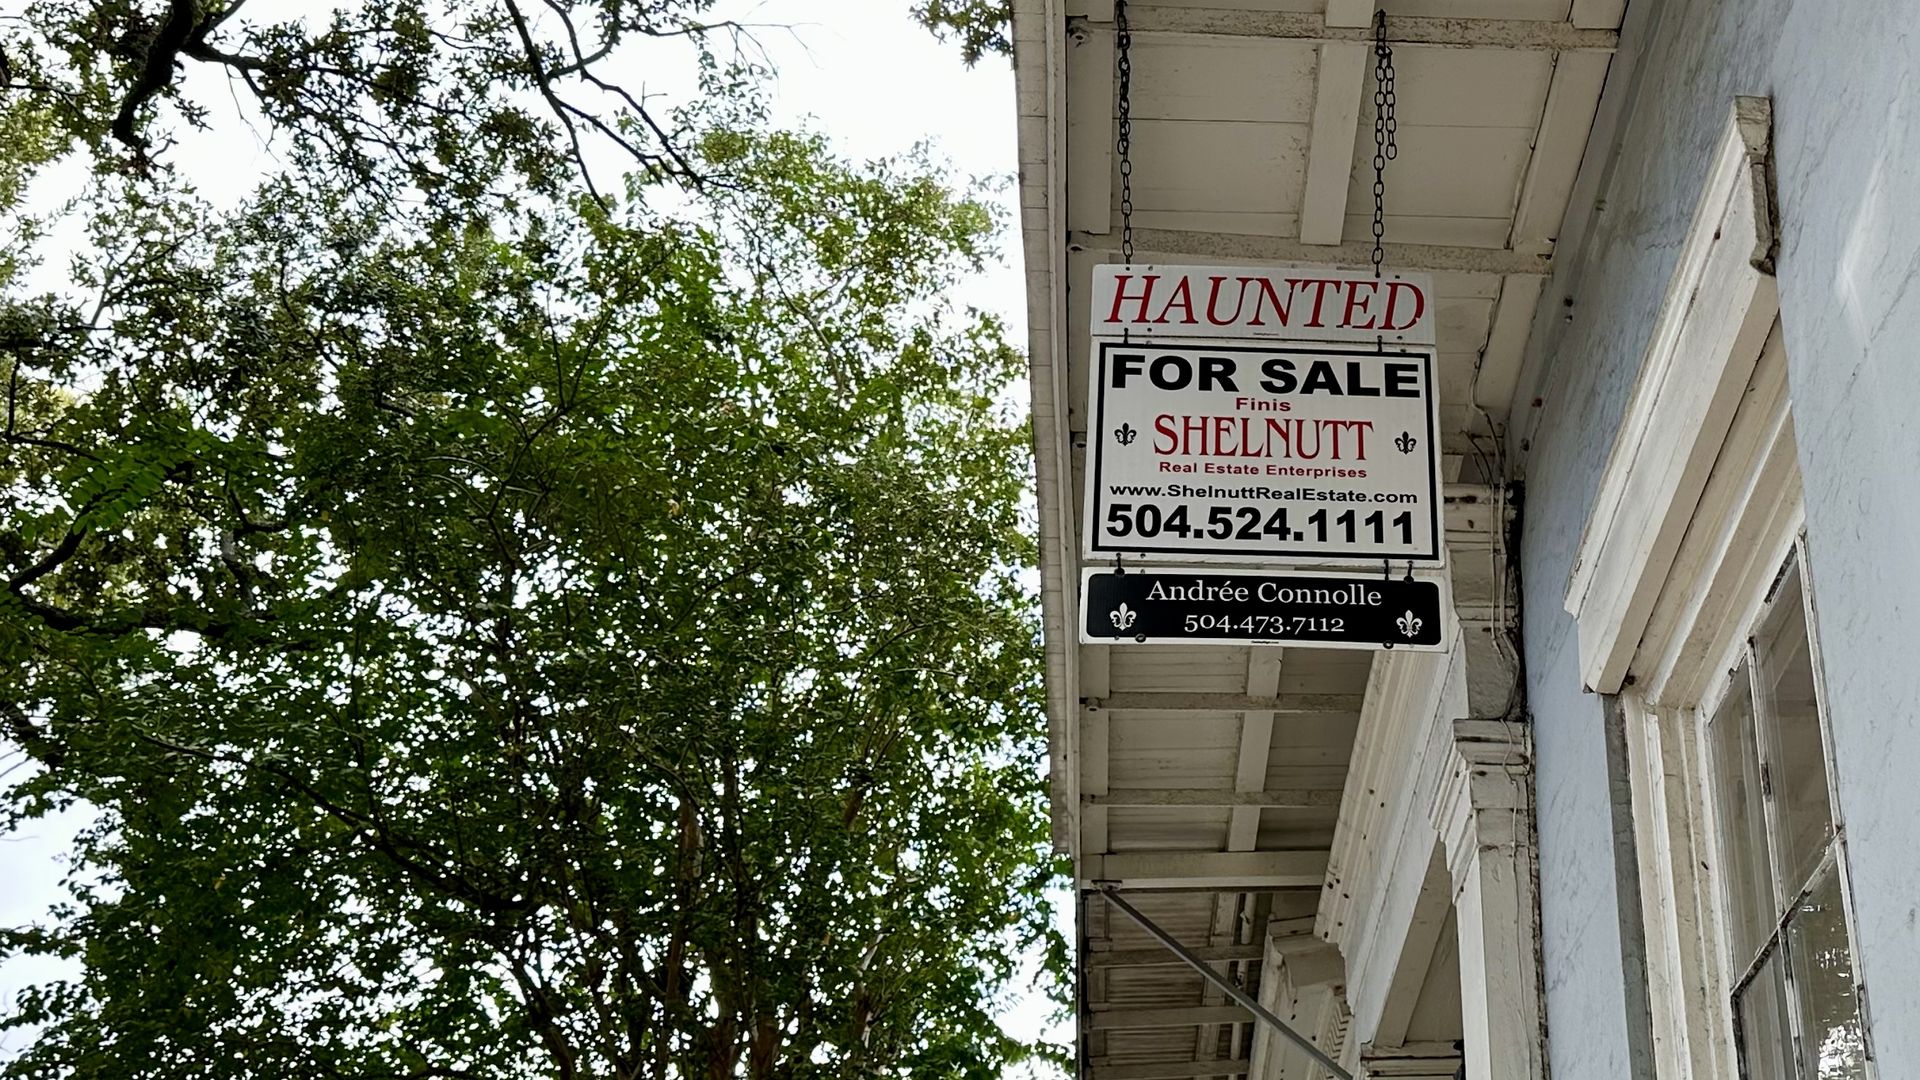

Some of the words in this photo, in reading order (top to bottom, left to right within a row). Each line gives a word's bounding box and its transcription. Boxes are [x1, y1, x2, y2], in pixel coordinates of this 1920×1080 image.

[1103, 274, 1425, 331] HAUNTED
[1112, 353, 1239, 393] FOR
[1259, 358, 1421, 398] SALE
[1235, 397, 1292, 412] Finis
[1153, 413, 1375, 461] SHELNUTT
[1159, 461, 1198, 474] Real
[1204, 462, 1260, 476] Estate
[1266, 464, 1367, 479] Enterprises
[1109, 484, 1418, 504] www.ShelnuttRealEstate.com
[1105, 503, 1414, 545] 504.524.1111
[1145, 580, 1250, 603] Andrée
[1257, 582, 1383, 607] Connolle
[1184, 614, 1345, 635] 504.473.7112
